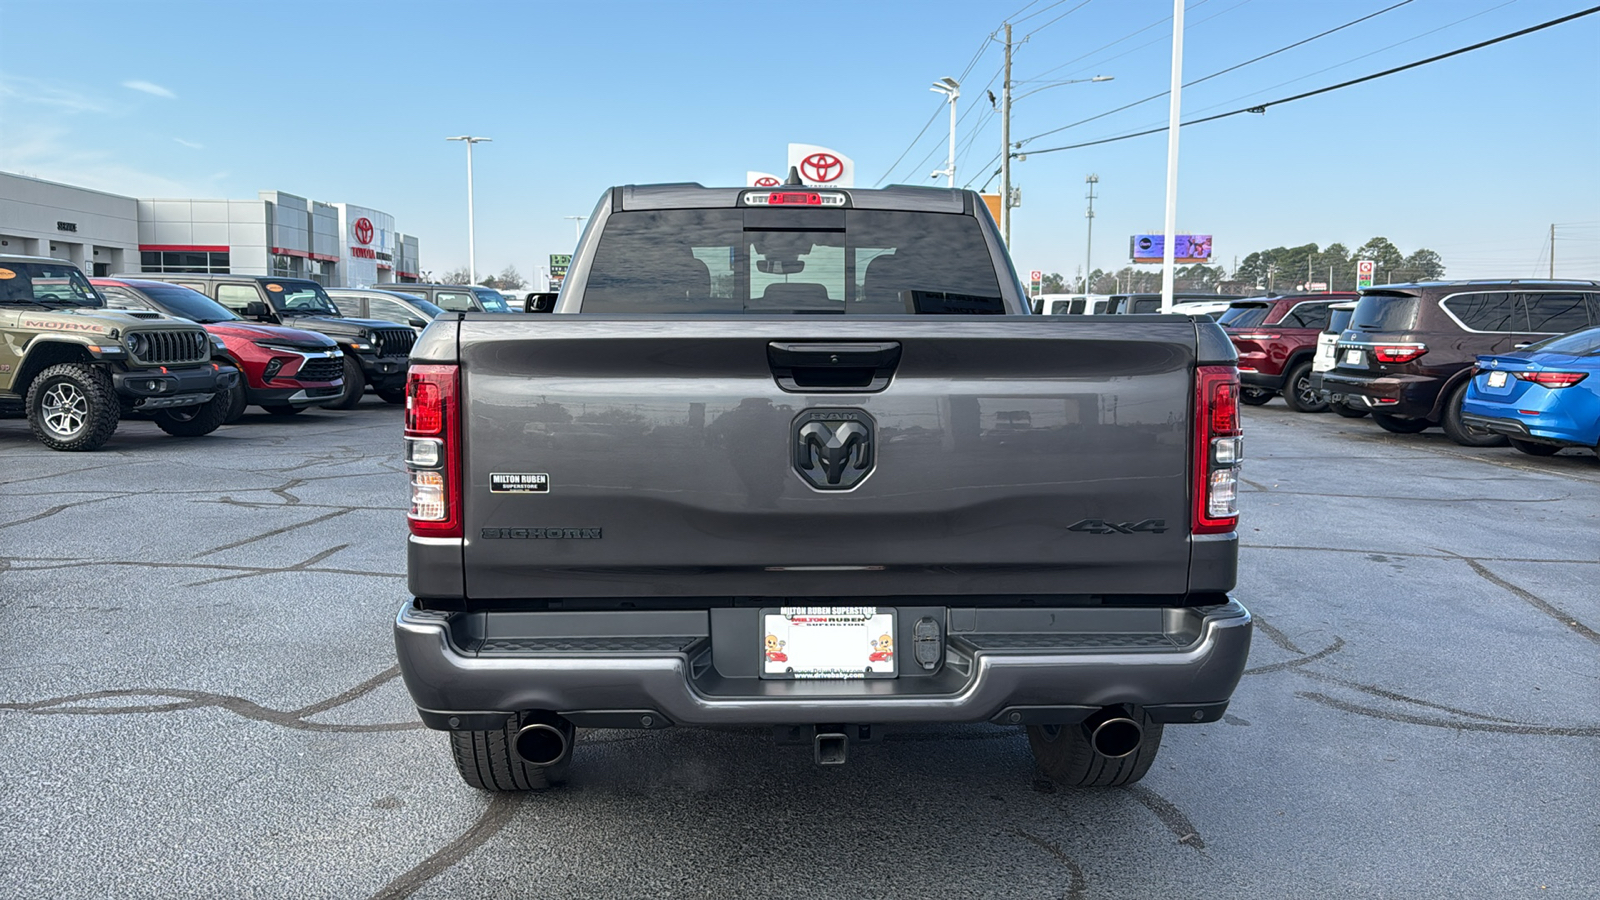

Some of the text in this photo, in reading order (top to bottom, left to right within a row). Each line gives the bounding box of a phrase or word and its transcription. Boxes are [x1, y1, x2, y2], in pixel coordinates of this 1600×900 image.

[351, 247, 375, 259] TOYOTA
[25, 320, 103, 331] MOJAVE
[493, 475, 546, 483] MILTON RUBEN
[781, 607, 876, 615] MILTON RUBEN SUPERSTORE
